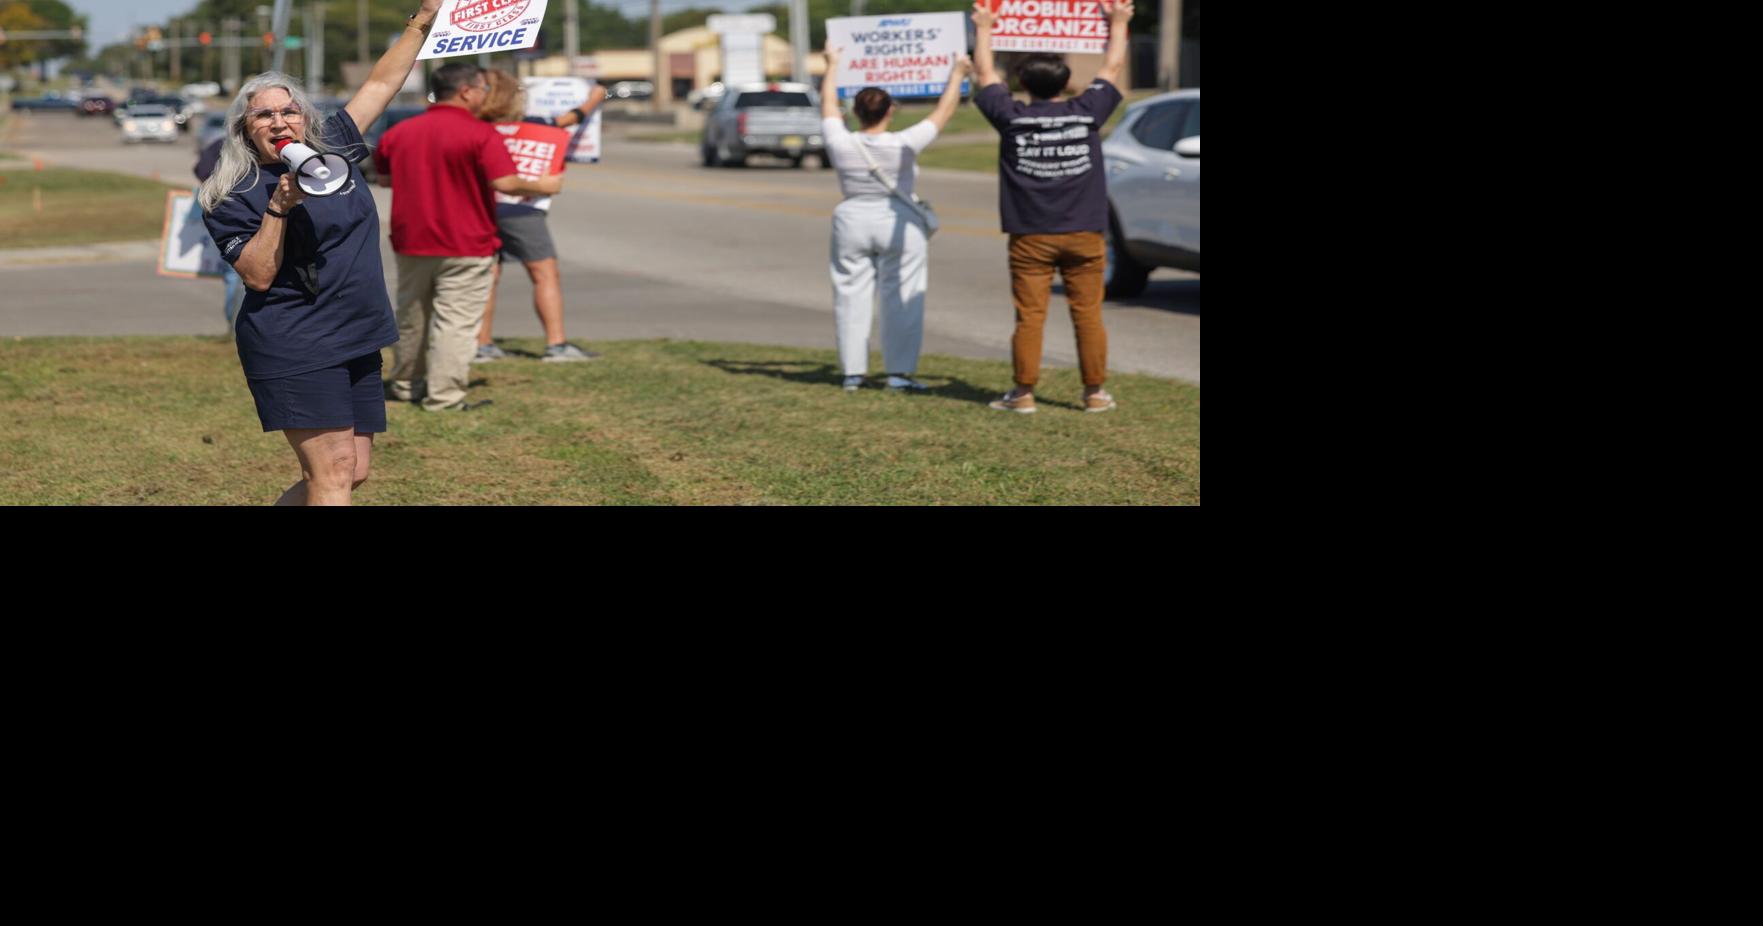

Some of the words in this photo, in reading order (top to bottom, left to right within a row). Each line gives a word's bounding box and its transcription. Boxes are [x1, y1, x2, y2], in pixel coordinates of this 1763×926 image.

[453, 2, 488, 21] FIRST
[1001, 0, 1105, 18] MOBILIZ
[465, 22, 492, 30] FIRST
[433, 27, 528, 54] SERVICE
[851, 28, 941, 43] WORKERS'
[864, 43, 925, 55] RIGHTS
[848, 58, 879, 70] ARE
[883, 55, 949, 68] HUMAN
[865, 69, 932, 82] RIGHTS!
[1042, 146, 1056, 157] IT
[1057, 144, 1090, 157] LOUD
